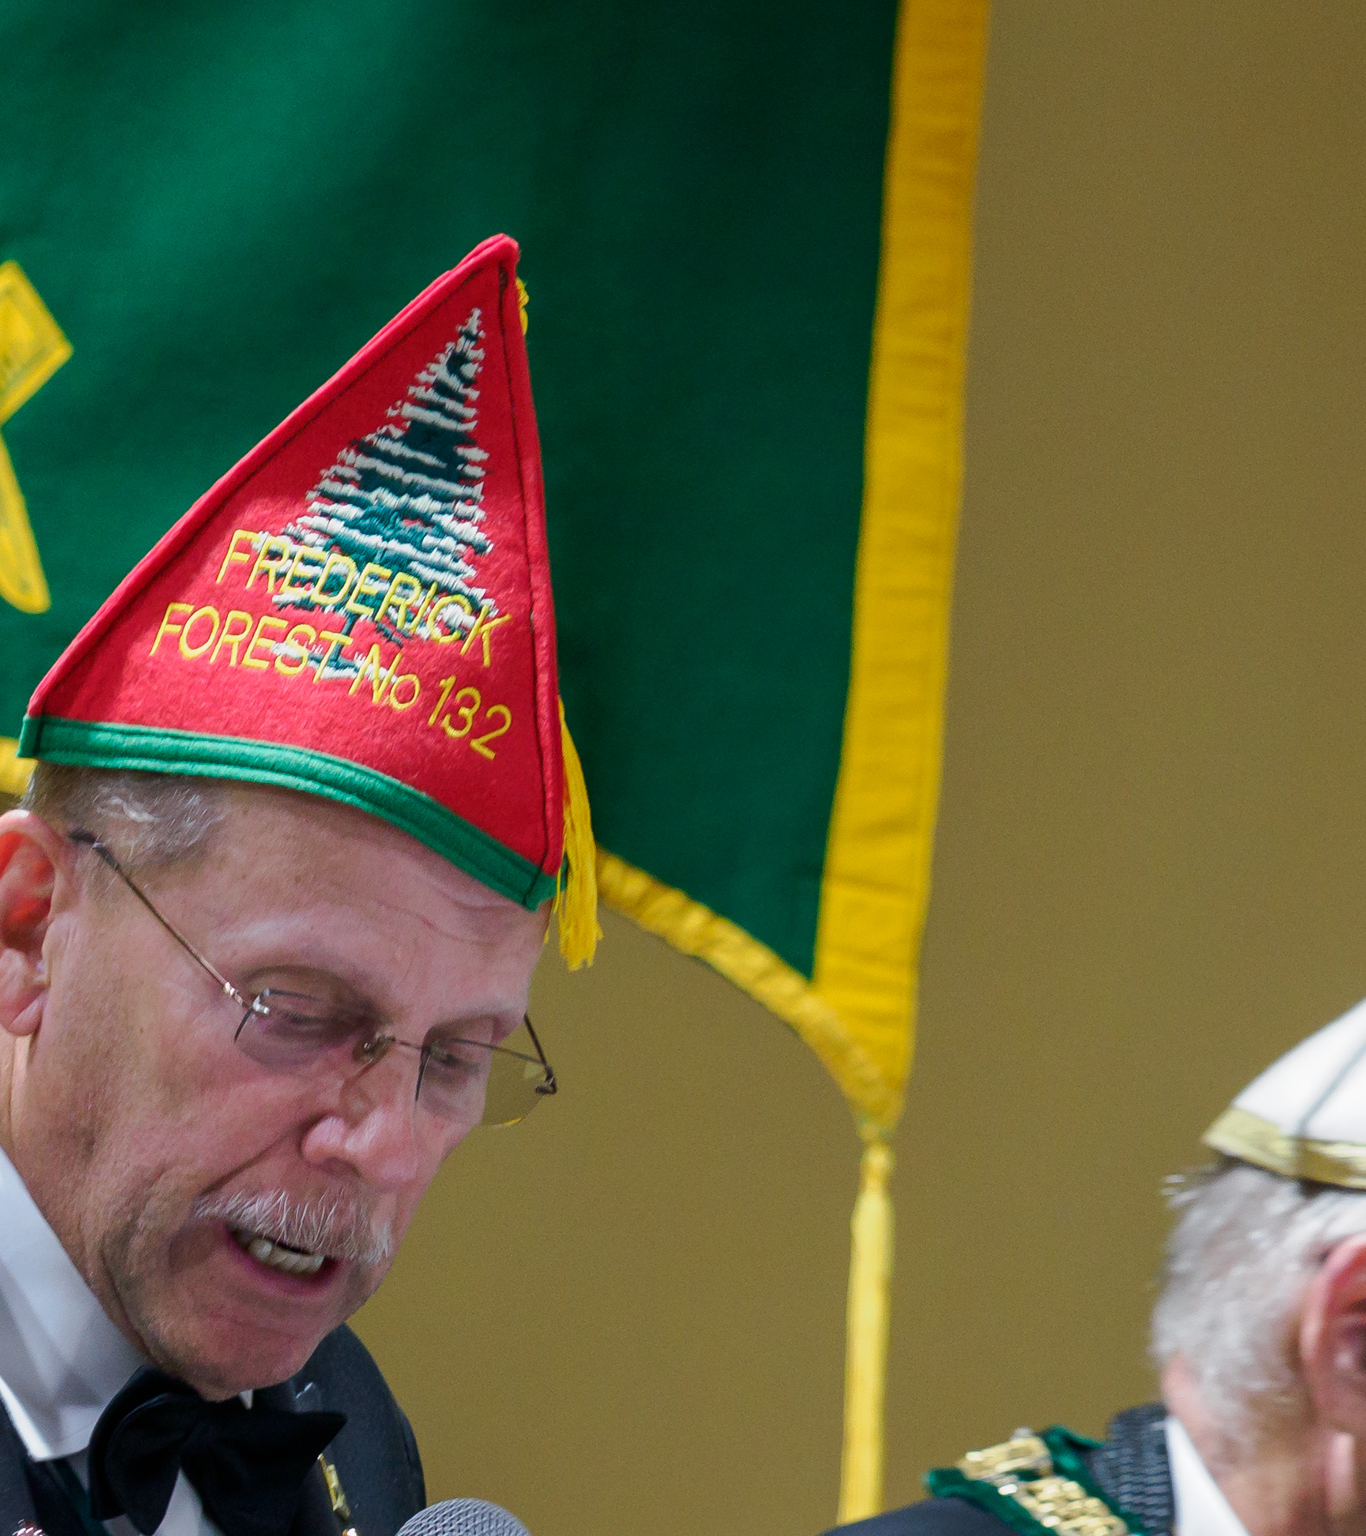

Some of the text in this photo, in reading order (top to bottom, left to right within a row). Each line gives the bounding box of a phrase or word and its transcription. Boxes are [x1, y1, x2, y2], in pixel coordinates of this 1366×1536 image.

[215, 529, 512, 667] FREDERICK
[149, 602, 512, 760] FOREST No 132
